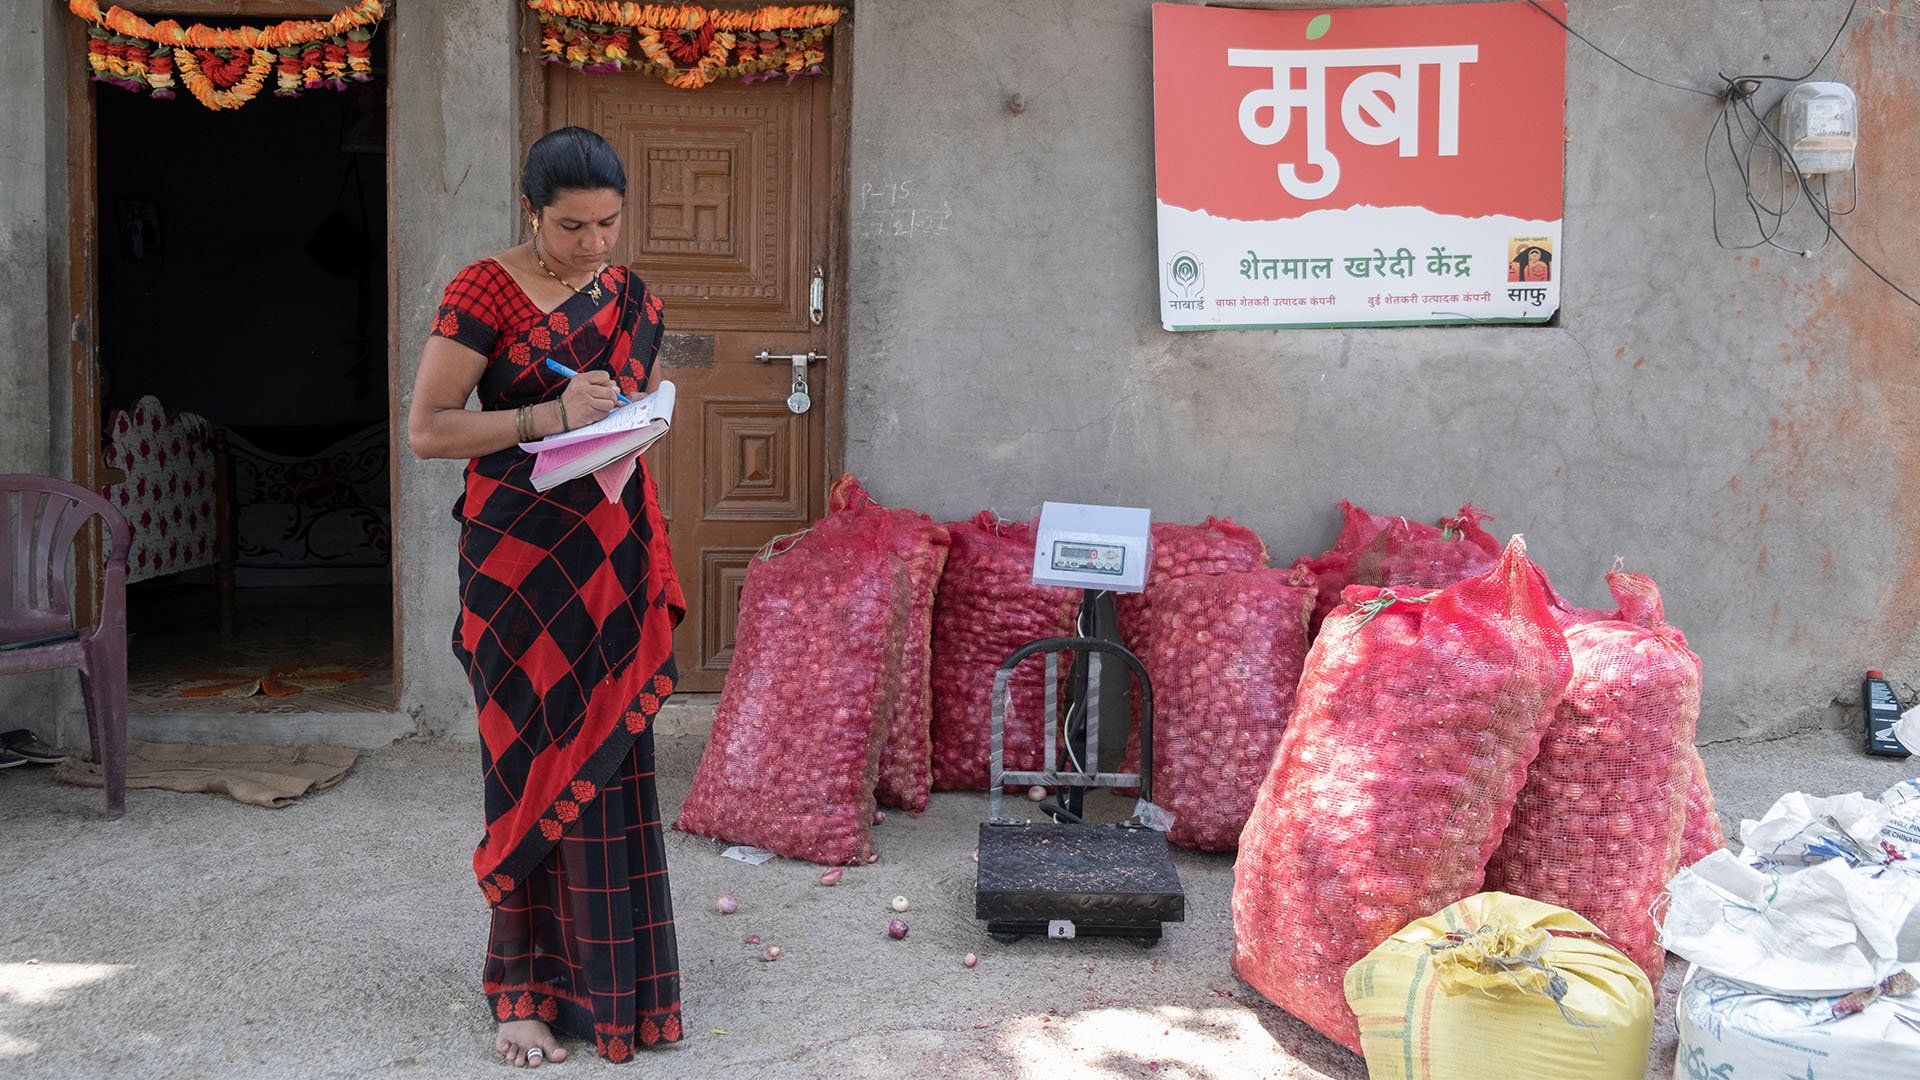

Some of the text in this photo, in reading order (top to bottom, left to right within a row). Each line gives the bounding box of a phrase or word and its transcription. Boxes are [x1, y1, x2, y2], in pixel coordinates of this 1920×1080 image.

[1228, 14, 1478, 200] मुंबा
[1239, 246, 1472, 281] शेतमाल खरेदी केंद्र
[1168, 296, 1205, 310] नाबार्ड
[1240, 295, 1269, 307] शेतकरी
[1272, 297, 1306, 307] उत्पादक
[1309, 294, 1336, 306] कंपनी
[1384, 292, 1418, 305] शेतकरी
[1421, 294, 1460, 304] उत्पादक
[1462, 290, 1492, 303] कंपनी
[1507, 288, 1547, 307] साफु
[1058, 926, 1065, 936] 8
